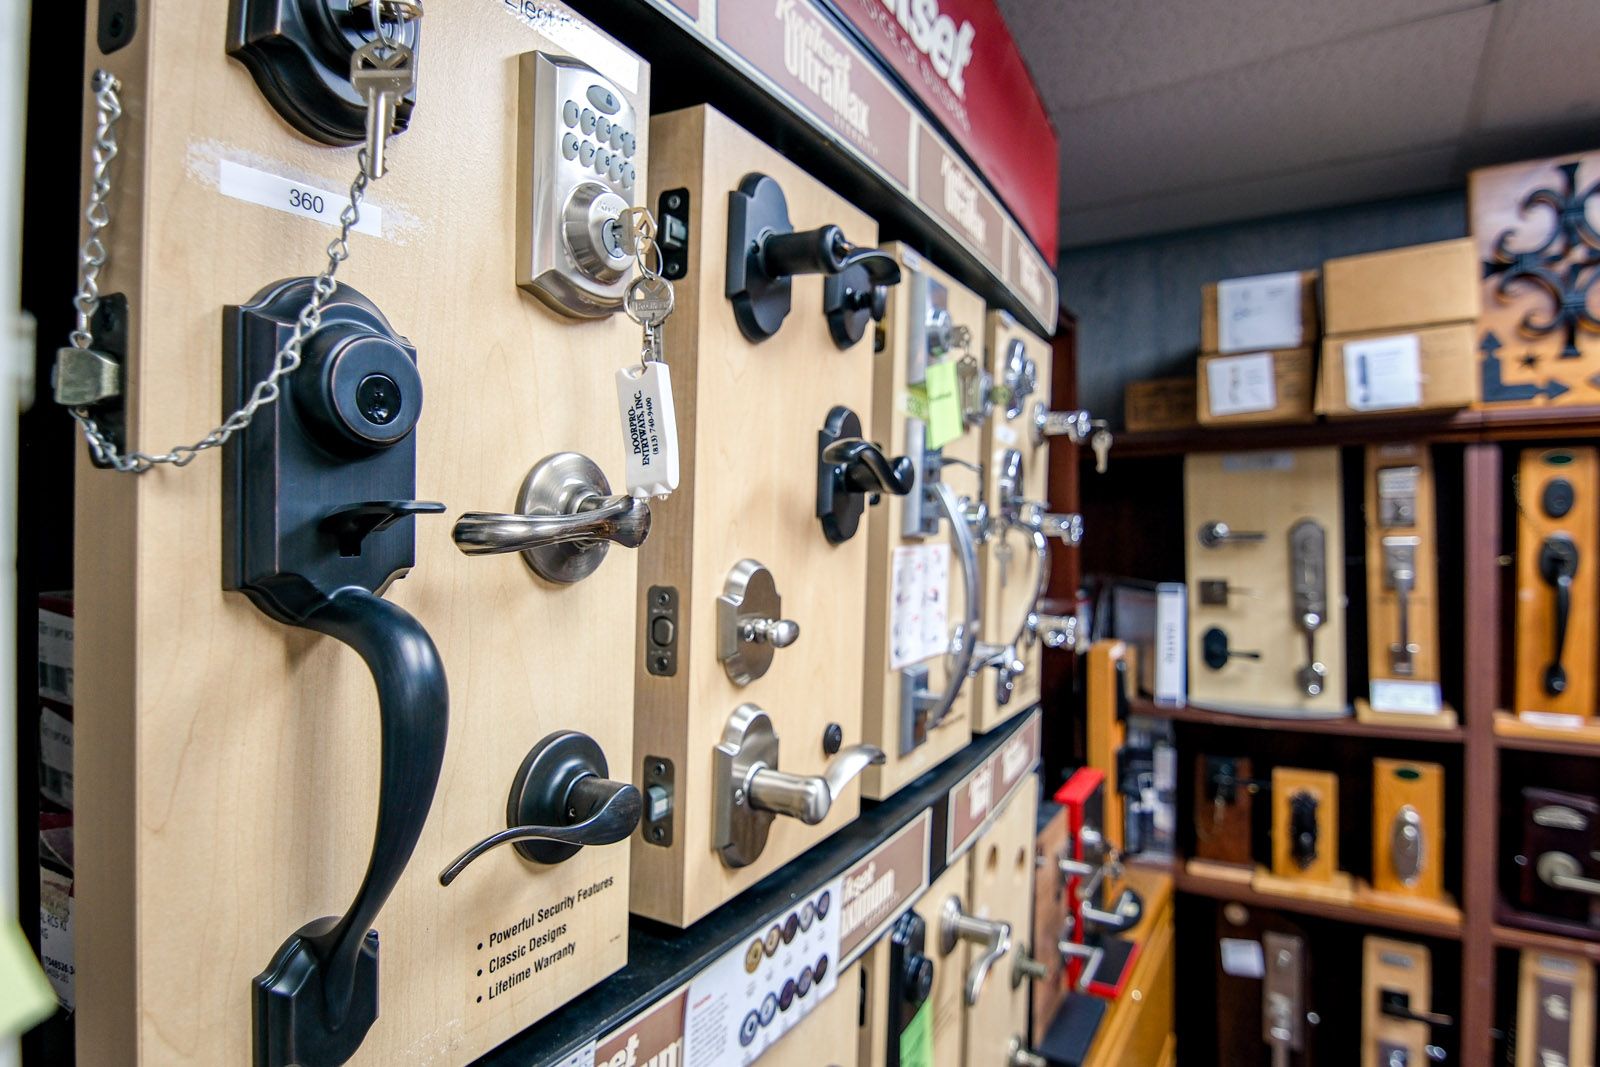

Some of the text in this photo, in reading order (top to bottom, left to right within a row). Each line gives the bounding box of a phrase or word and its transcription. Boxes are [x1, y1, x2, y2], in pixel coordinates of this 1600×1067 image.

[784, 10, 870, 138] UltraMax
[289, 189, 324, 213] 360
[634, 390, 643, 409] INC.
[628, 406, 641, 454] DOORPRO-
[651, 435, 659, 455] (813)
[489, 876, 614, 947] Powerful Security Features
[488, 941, 576, 1000] Lifetime Warranty
[489, 923, 567, 974] Classic Designs
